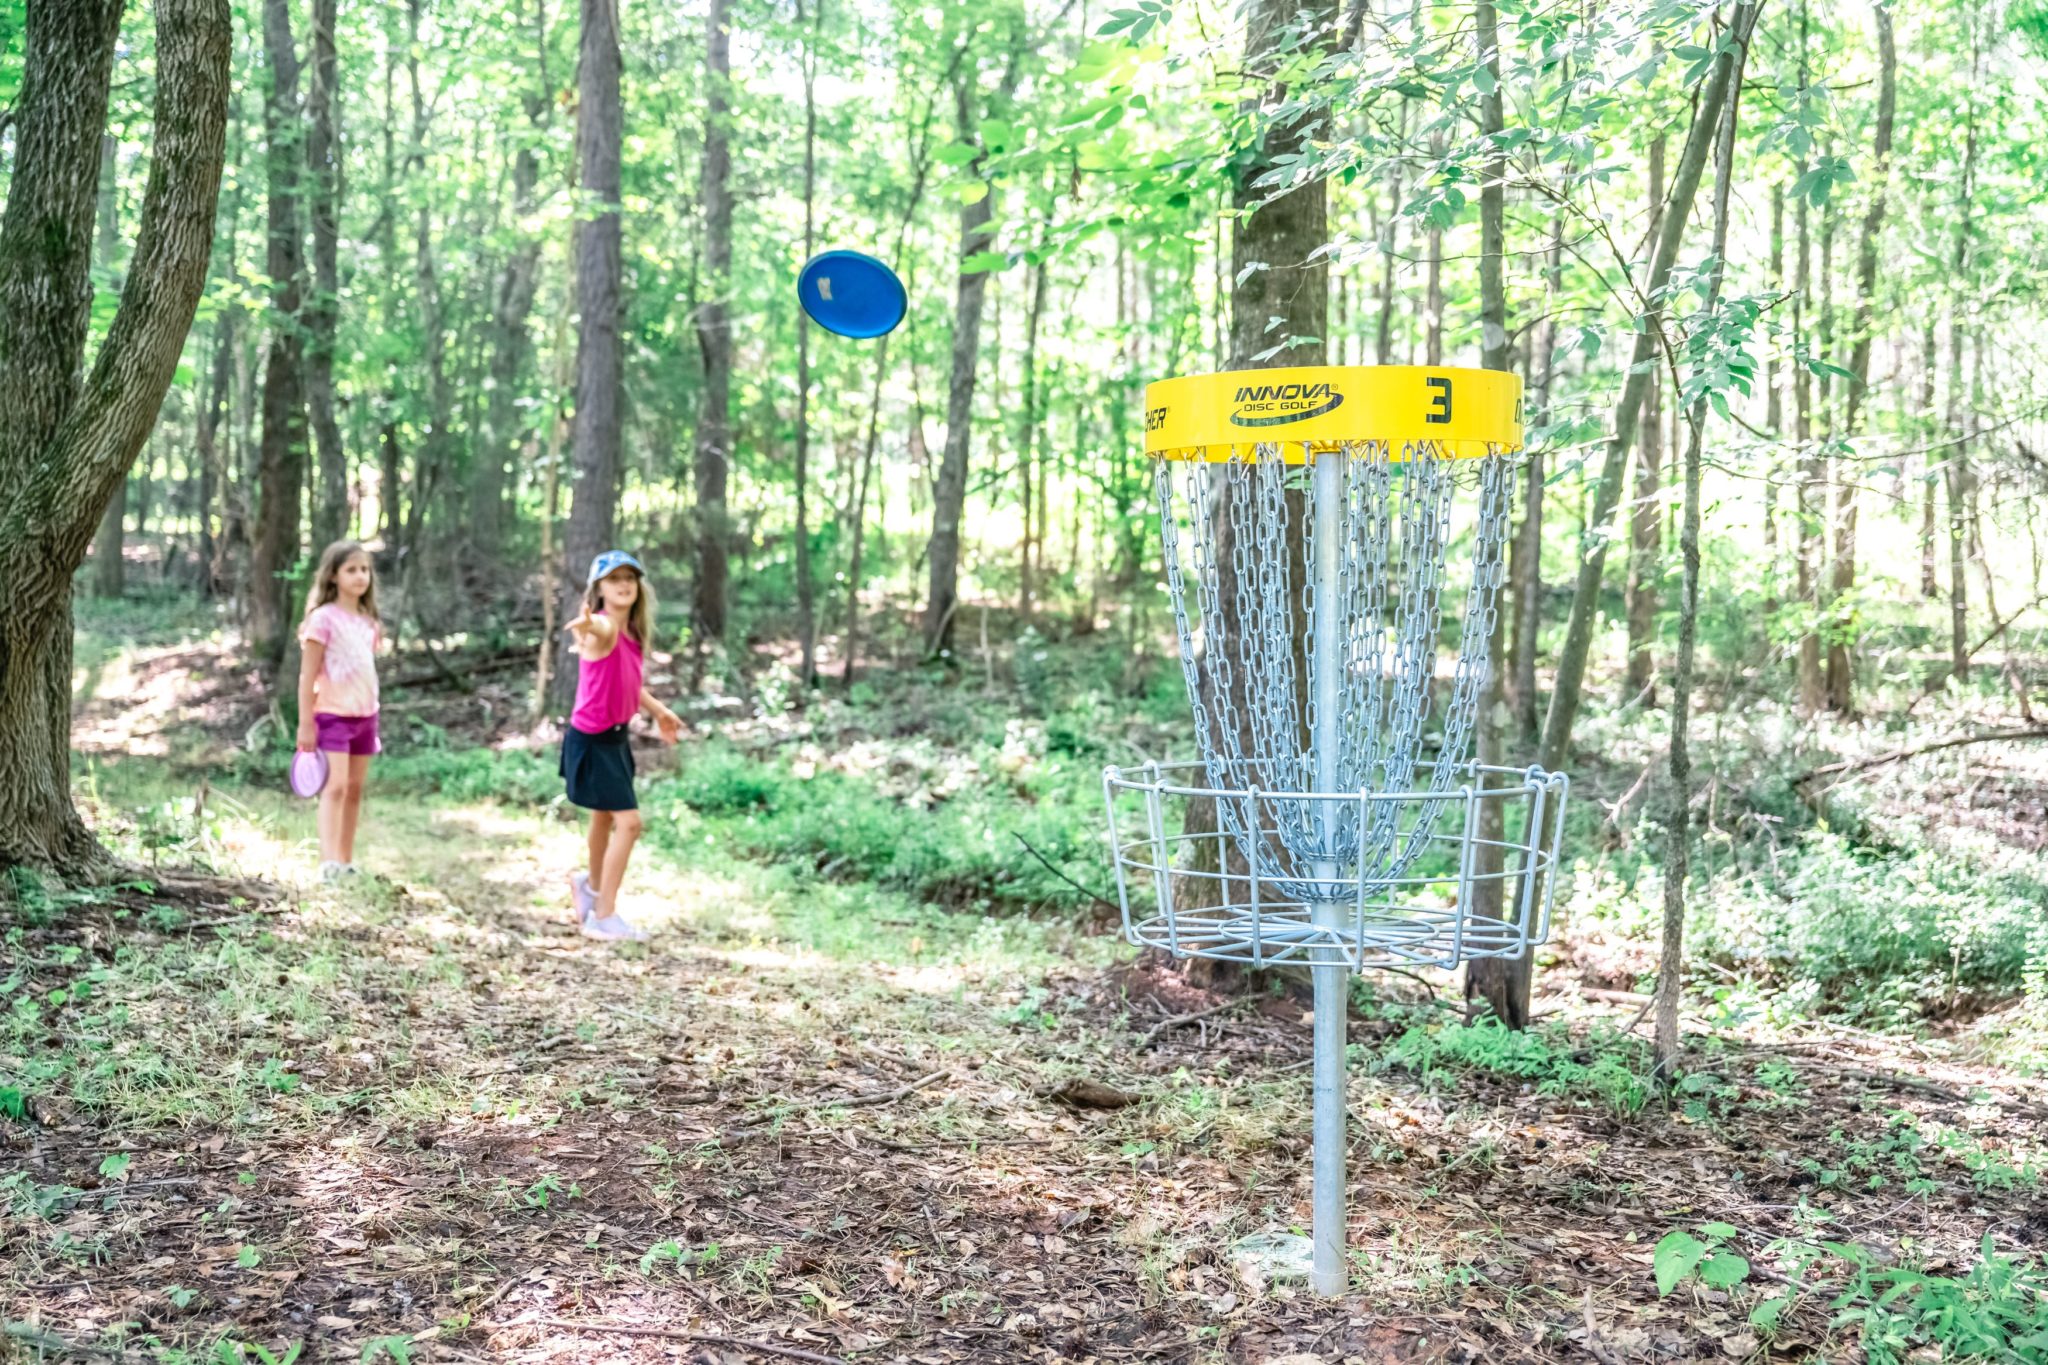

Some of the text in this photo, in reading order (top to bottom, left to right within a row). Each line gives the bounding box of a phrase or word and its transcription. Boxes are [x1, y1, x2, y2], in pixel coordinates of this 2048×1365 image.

[1244, 400, 1318, 412] DISC GOLF
[1426, 377, 1451, 423] 3
